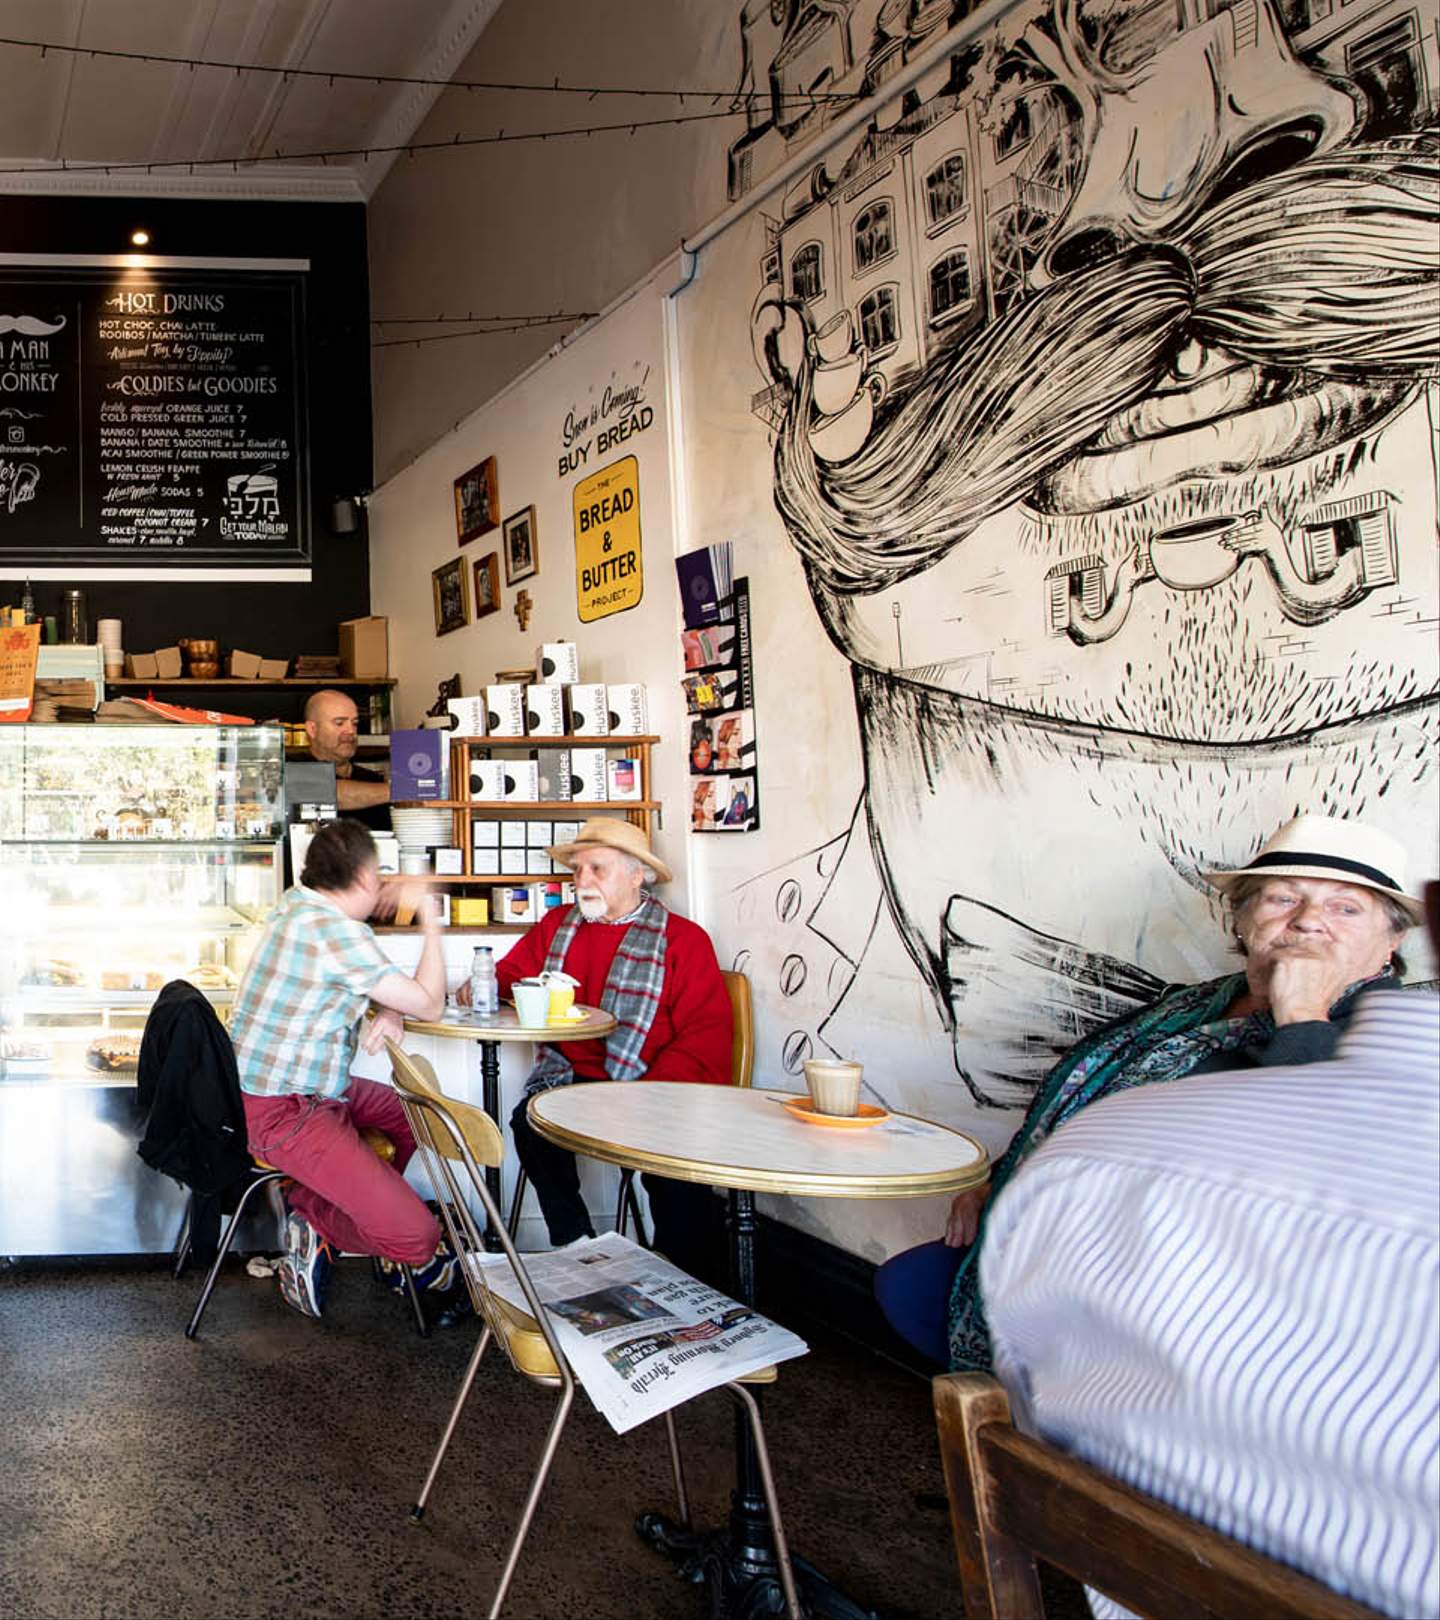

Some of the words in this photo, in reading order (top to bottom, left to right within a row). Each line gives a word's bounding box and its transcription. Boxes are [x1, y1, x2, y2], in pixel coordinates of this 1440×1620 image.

[112, 293, 157, 314] HOT
[164, 293, 225, 314] DRINKS
[100, 330, 145, 340] ROOIBOS
[152, 331, 193, 341] MATCHA
[185, 321, 217, 332] LATTE
[10, 340, 49, 360] MAN
[116, 375, 185, 396] COLDIES
[204, 376, 278, 396] GOODIES
[100, 413, 128, 423] COLD
[130, 414, 171, 423] PRESSED
[172, 414, 205, 423] GREEN
[208, 415, 235, 424] JUICE
[203, 404, 231, 414] JUICE
[100, 439, 140, 447] BANANA
[173, 439, 222, 448] SMOOTHIE
[184, 428, 235, 438] SMOOTHIE
[559, 439, 593, 479] BUY
[597, 406, 654, 455] BREAD
[125, 449, 173, 458] SMOOTHIE
[100, 464, 134, 473] LEMON
[135, 464, 165, 474] CRUSH
[160, 487, 192, 497] SODAS
[580, 487, 634, 534] BREAD
[100, 525, 137, 535] SHAKES
[602, 531, 613, 553] &
[582, 550, 637, 592] BUTTER
[591, 588, 627, 608] PROJECT
[569, 646, 577, 681] Huskee
[511, 687, 520, 735] Huskee
[551, 688, 560, 735] Huskee
[595, 688, 606, 735] Huskee
[632, 687, 641, 735] Huskee
[560, 753, 569, 799] Huskee
[594, 752, 603, 800] Huskee
[722, 1323, 768, 1349] Sydney
[668, 1342, 724, 1366] Morning
[631, 1360, 676, 1394] Herald
